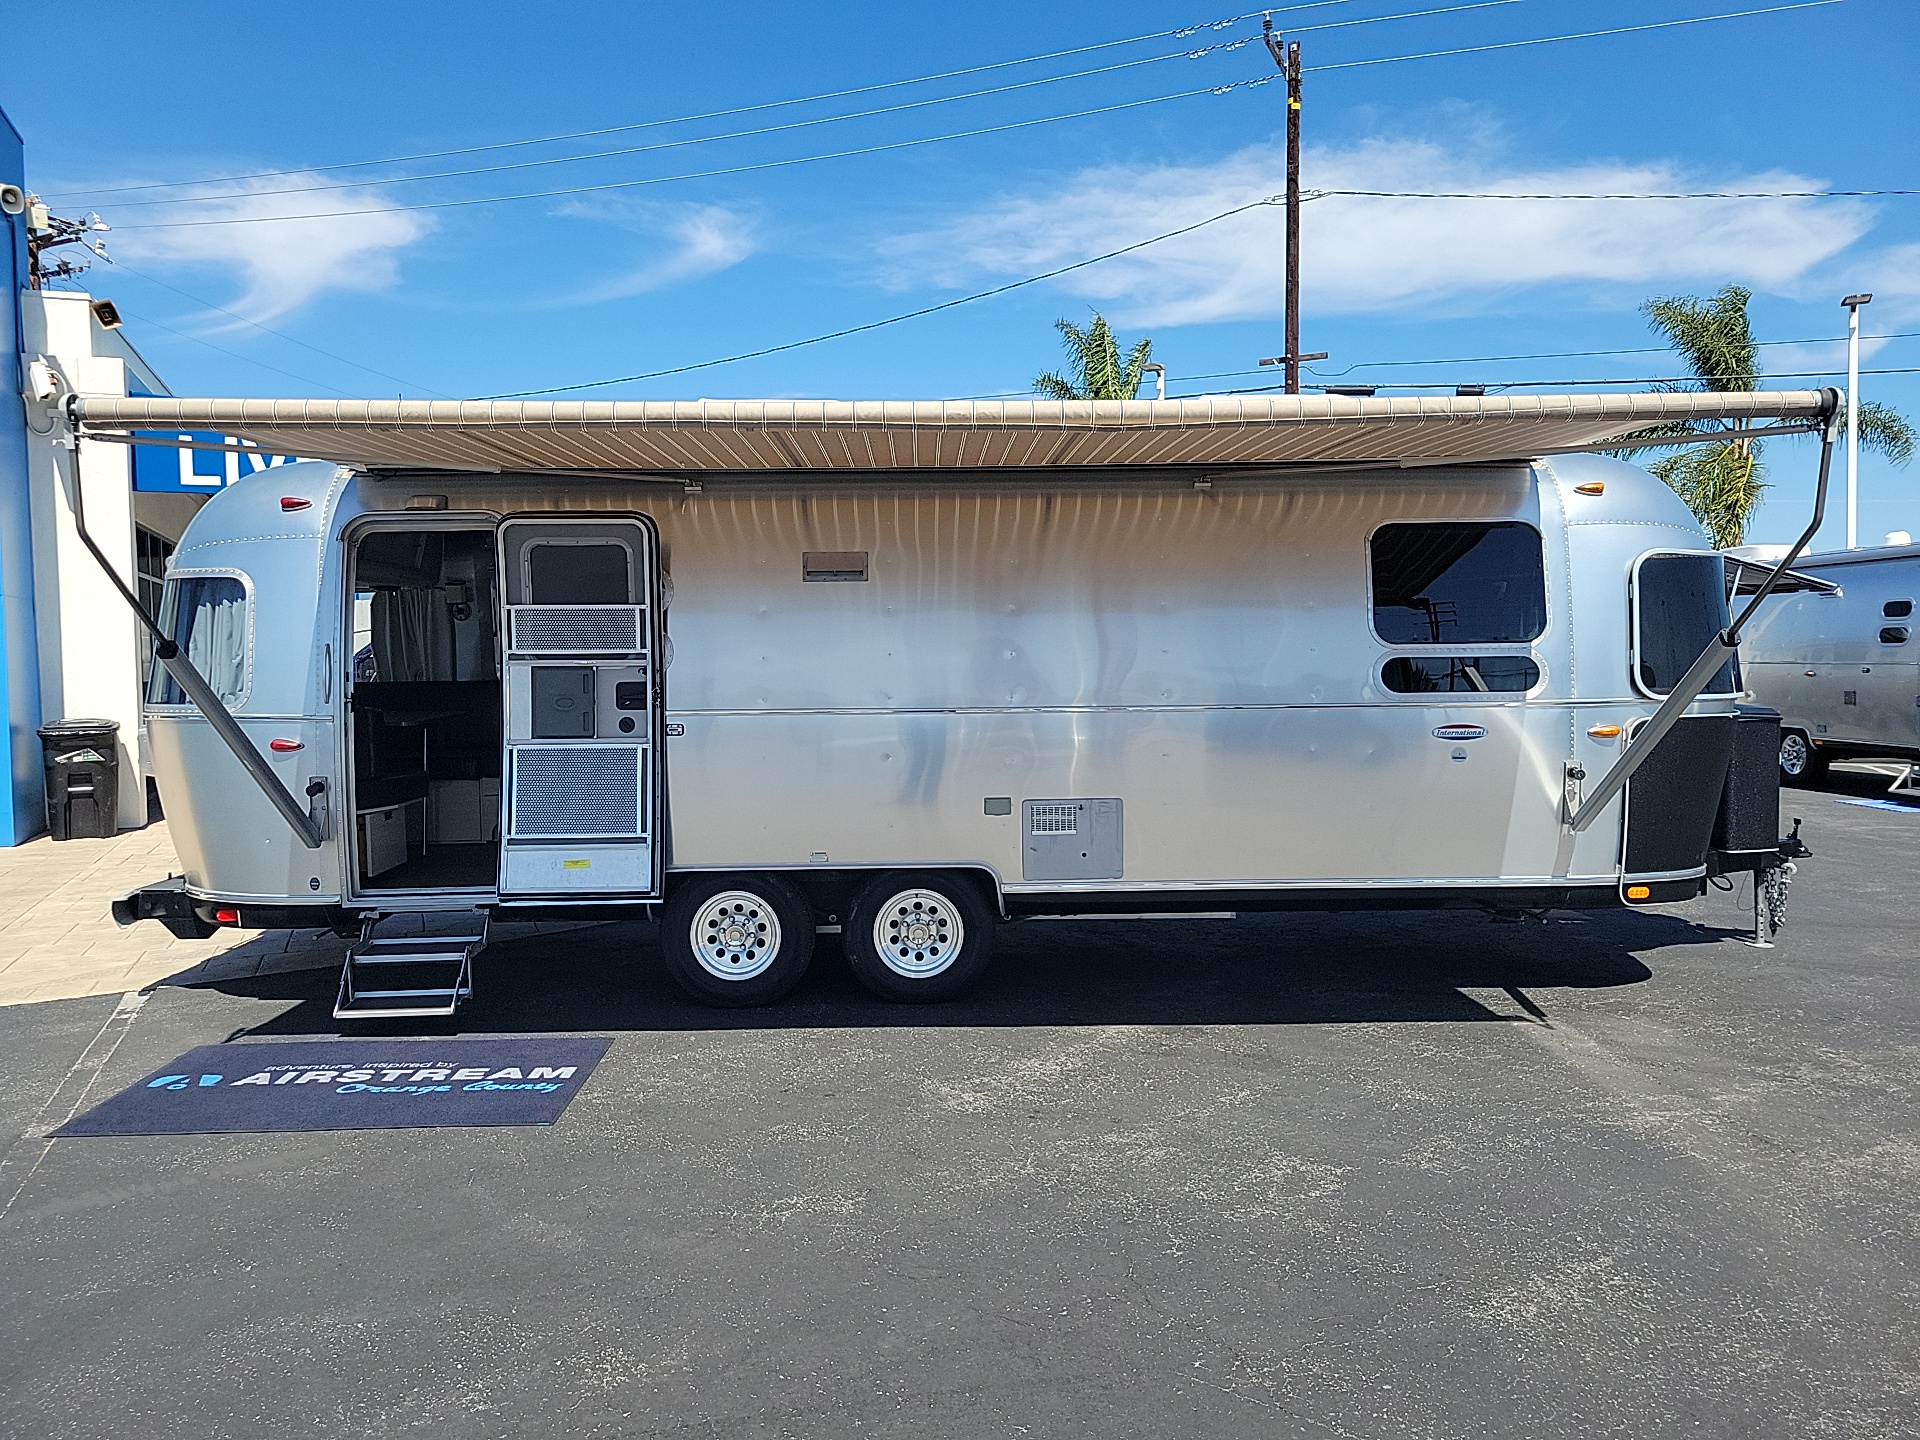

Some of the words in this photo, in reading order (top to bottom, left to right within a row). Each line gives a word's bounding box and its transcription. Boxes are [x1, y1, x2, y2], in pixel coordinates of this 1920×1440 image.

[229, 1066, 578, 1086] AIRSTREAM
[335, 1083, 453, 1096] Orange
[462, 1080, 564, 1094] County
